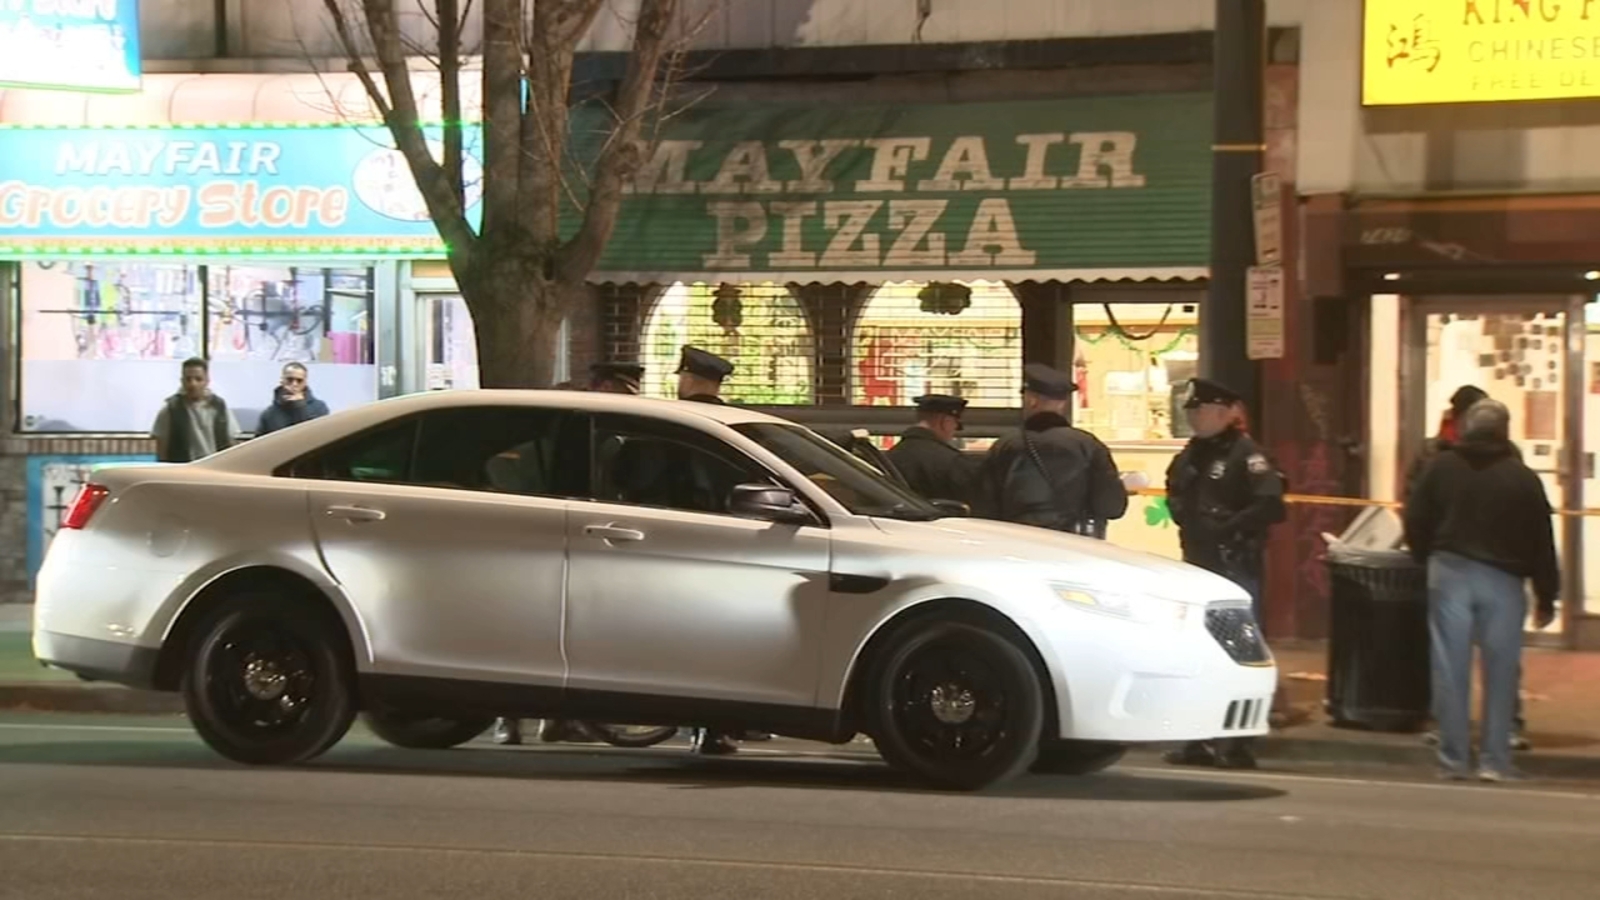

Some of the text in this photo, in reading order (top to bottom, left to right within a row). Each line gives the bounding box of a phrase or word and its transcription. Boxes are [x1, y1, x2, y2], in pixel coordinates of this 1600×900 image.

[1468, 36, 1600, 62] CHINESE
[55, 140, 281, 175] MAYFAIR
[620, 131, 1145, 194] MAYFAIR
[199, 181, 348, 228] Store
[702, 198, 1036, 268] PIZZA
